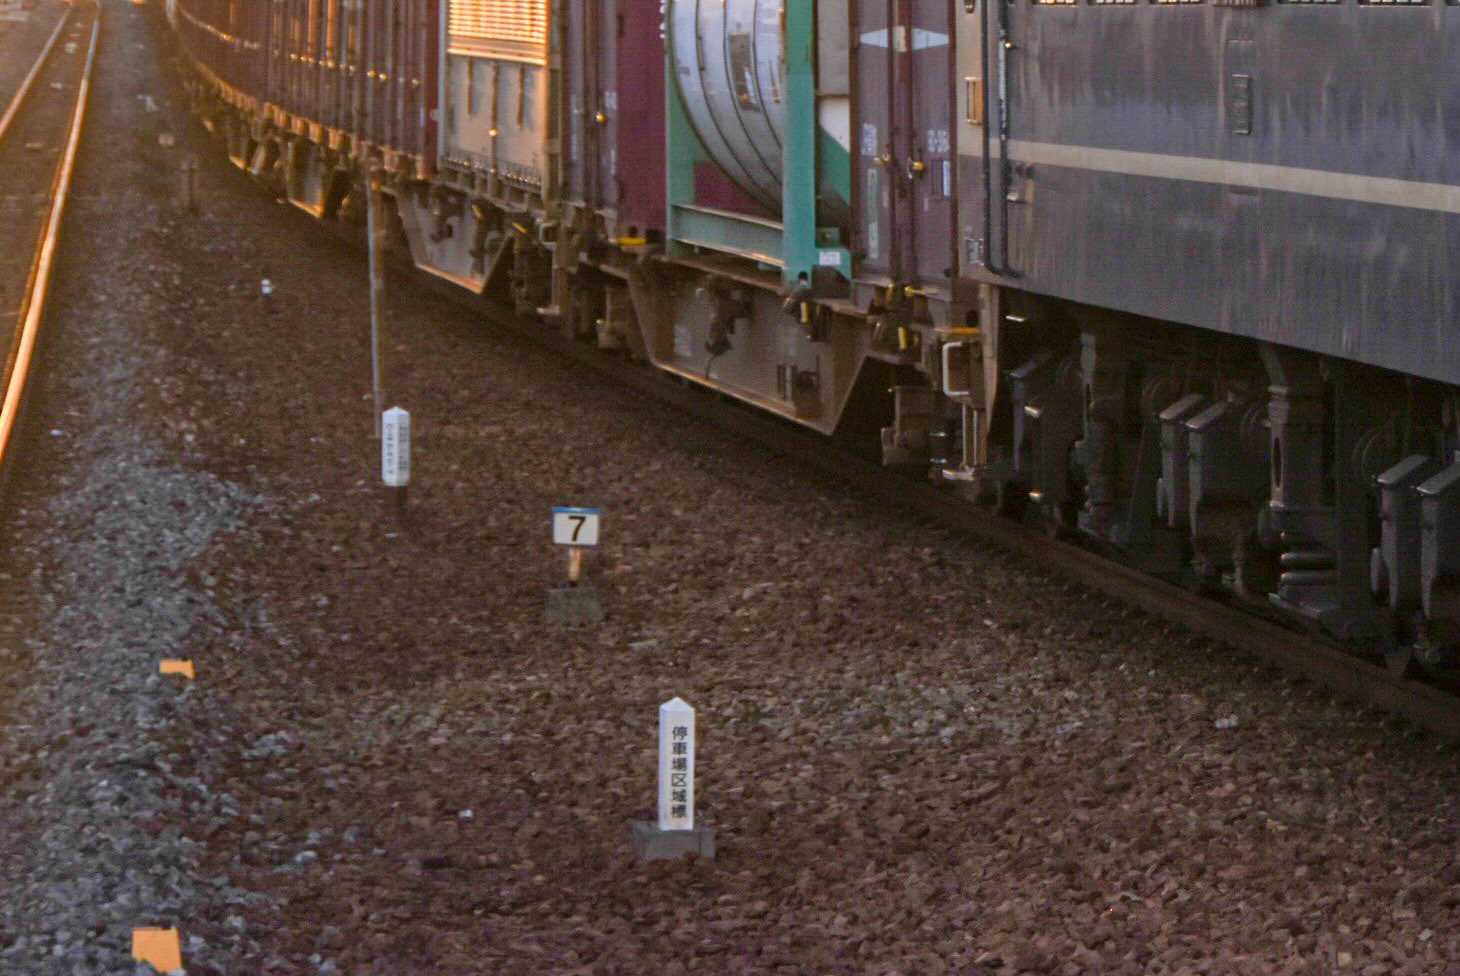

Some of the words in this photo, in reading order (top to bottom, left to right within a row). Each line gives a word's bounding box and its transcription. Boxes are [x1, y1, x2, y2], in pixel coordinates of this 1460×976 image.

[568, 515, 586, 542] 7
[671, 725, 688, 818] 停車場区域標
